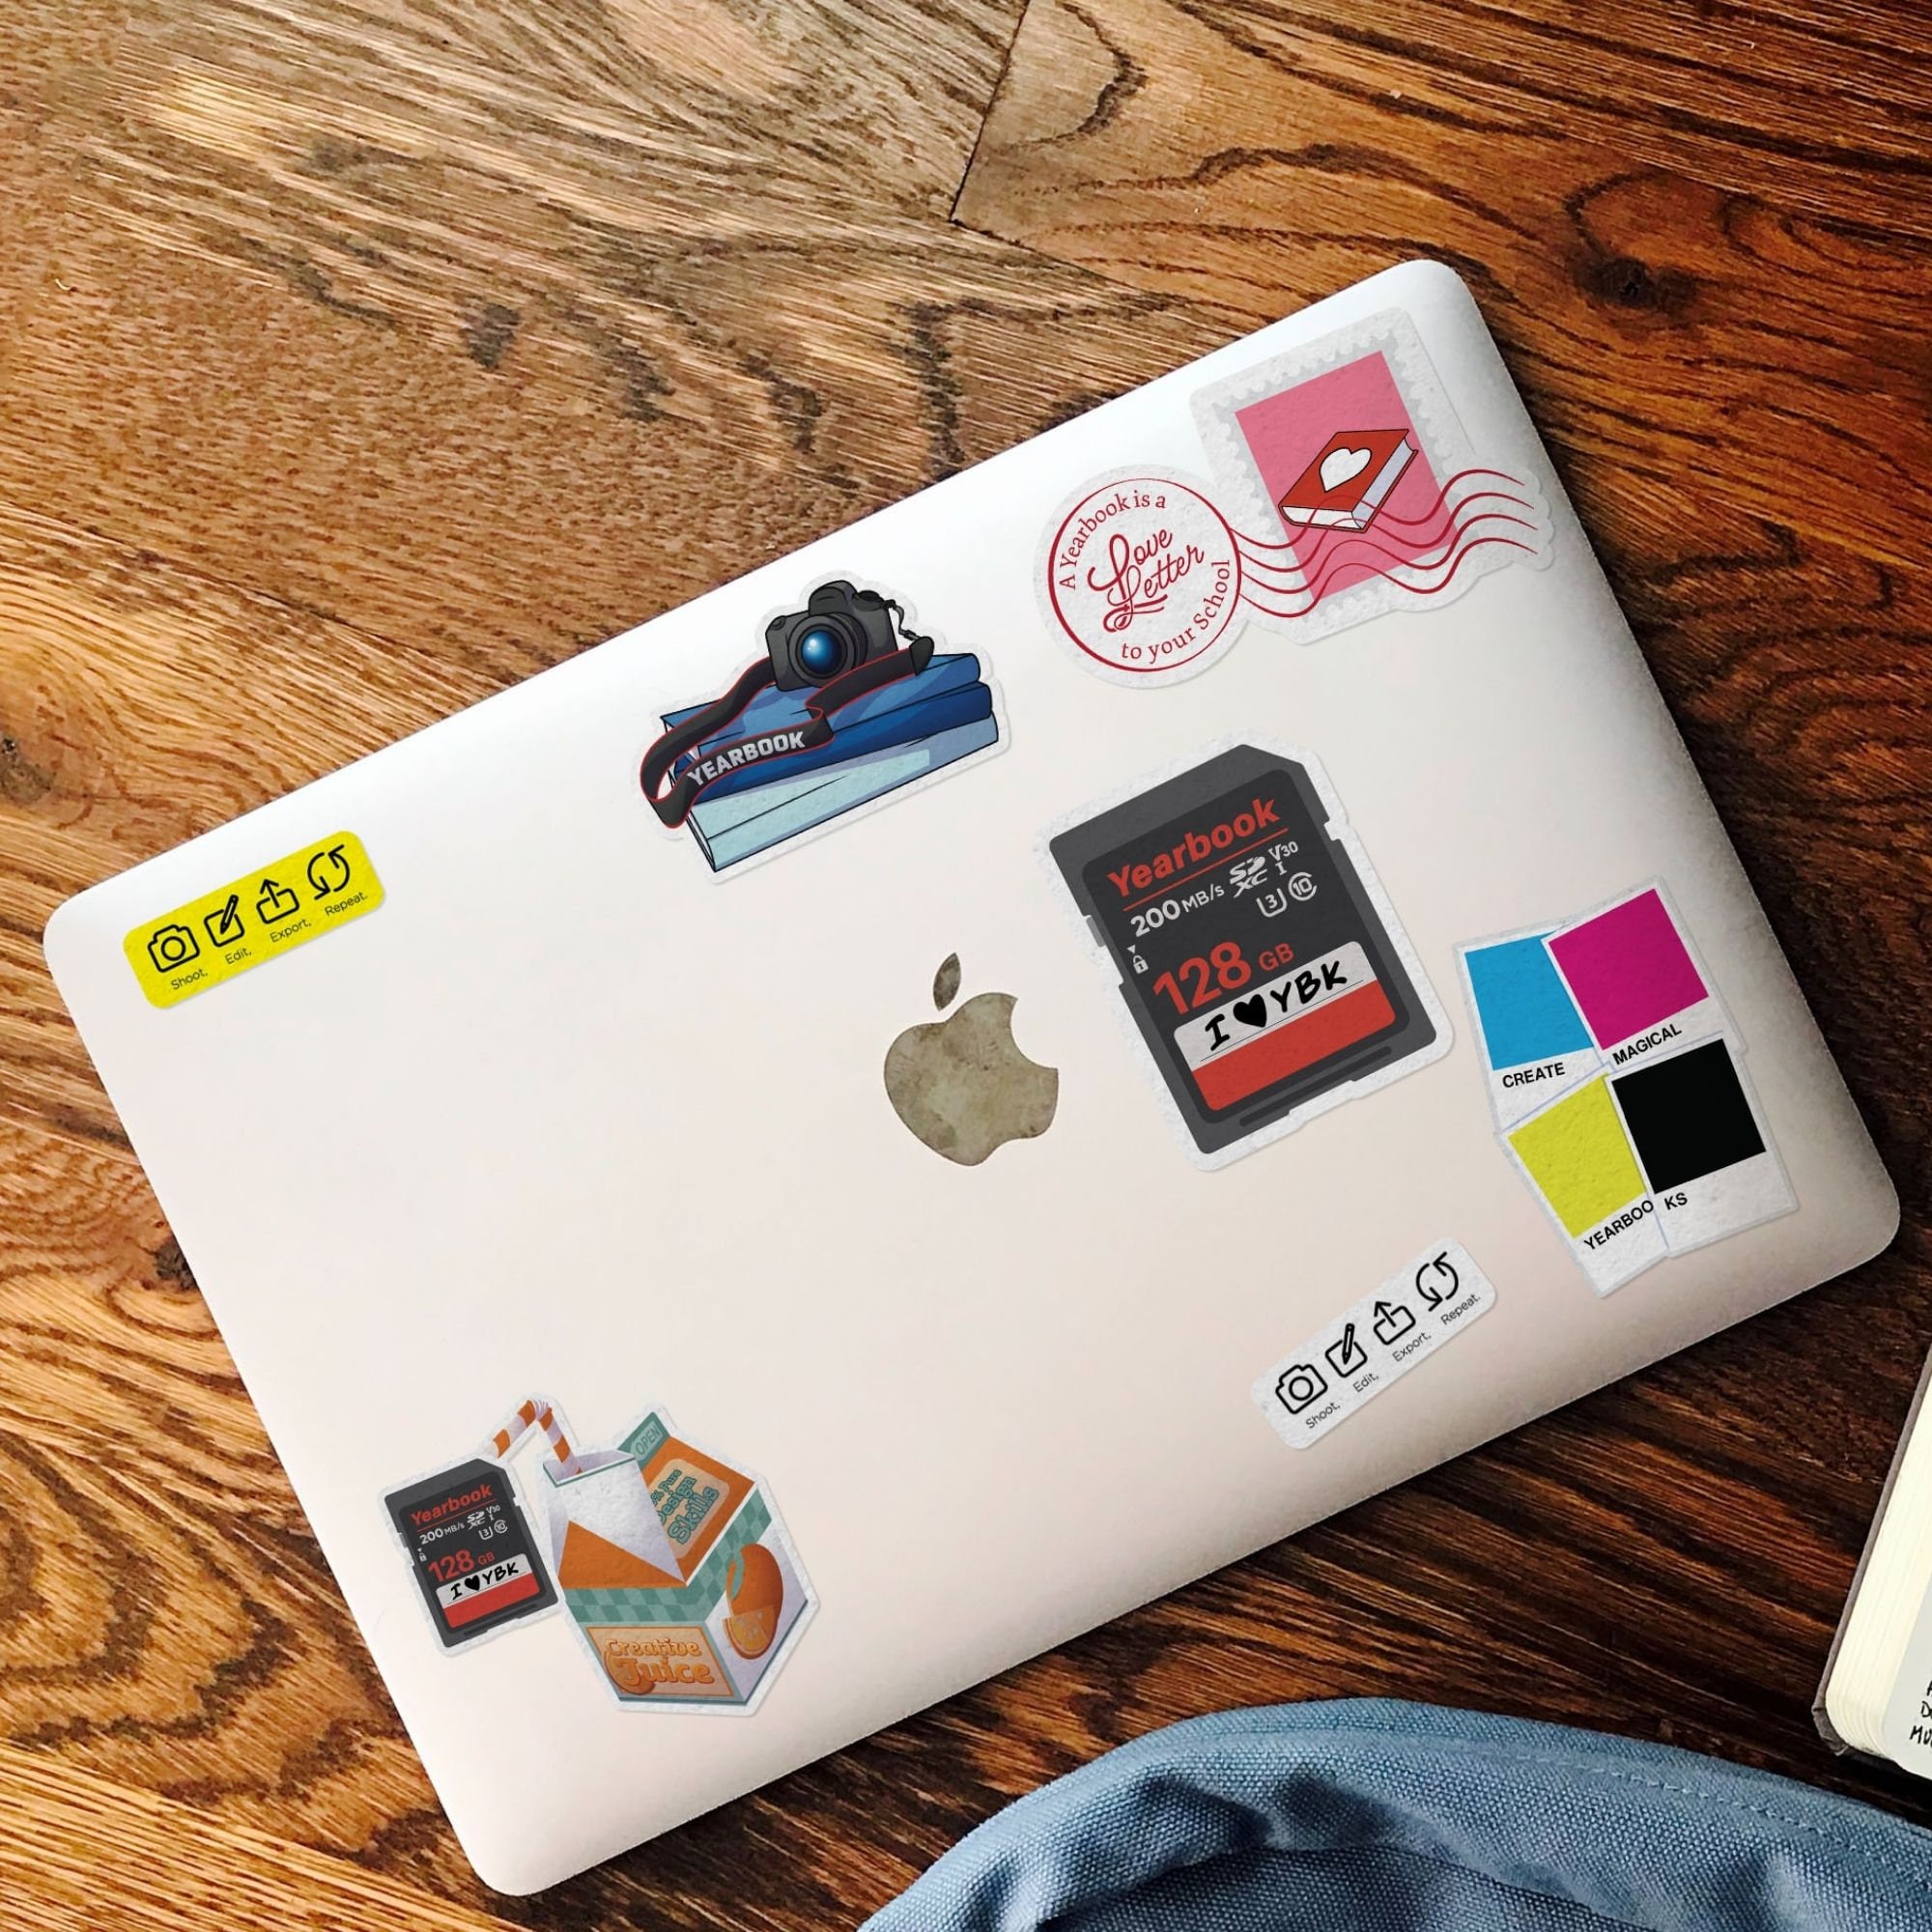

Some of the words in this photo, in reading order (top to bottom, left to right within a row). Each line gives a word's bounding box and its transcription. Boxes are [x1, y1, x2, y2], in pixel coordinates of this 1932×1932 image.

[1134, 490, 1151, 508] is
[1155, 495, 1166, 509] a
[1060, 494, 1130, 570] Yearbook
[1060, 575, 1076, 590] A
[1087, 529, 1173, 633] Love
[1107, 545, 1205, 631] Letter
[1122, 643, 1142, 660] to
[1149, 628, 1197, 665] your
[1193, 559, 1230, 630] School
[686, 730, 806, 786] YEARBOOK
[1107, 797, 1280, 897] Yearbook
[1130, 899, 1180, 937] 200
[1181, 883, 1225, 913] MB/s
[1267, 841, 1298, 862] V30
[1152, 941, 1252, 1015] 128
[1259, 943, 1294, 971] GB
[1205, 1013, 1230, 1051] I
[1269, 960, 1348, 1013] YBK
[1612, 1023, 1683, 1065] MAGICAL
[1502, 1062, 1566, 1088] CREATE
[1582, 1199, 1655, 1251] YEARBOO
[1663, 1192, 1689, 1210] KS
[635, 1424, 662, 1456] OPEN
[411, 1483, 493, 1525] Yearbook
[668, 1486, 720, 1545] Skills
[419, 1528, 443, 1546] 200
[444, 1521, 465, 1536] MB/s
[428, 1548, 475, 1582] 128
[477, 1551, 496, 1566] GB
[450, 1583, 463, 1601] I
[482, 1562, 519, 1584] YBK
[604, 1636, 702, 1657] Creative
[616, 1657, 715, 1687] Juice
